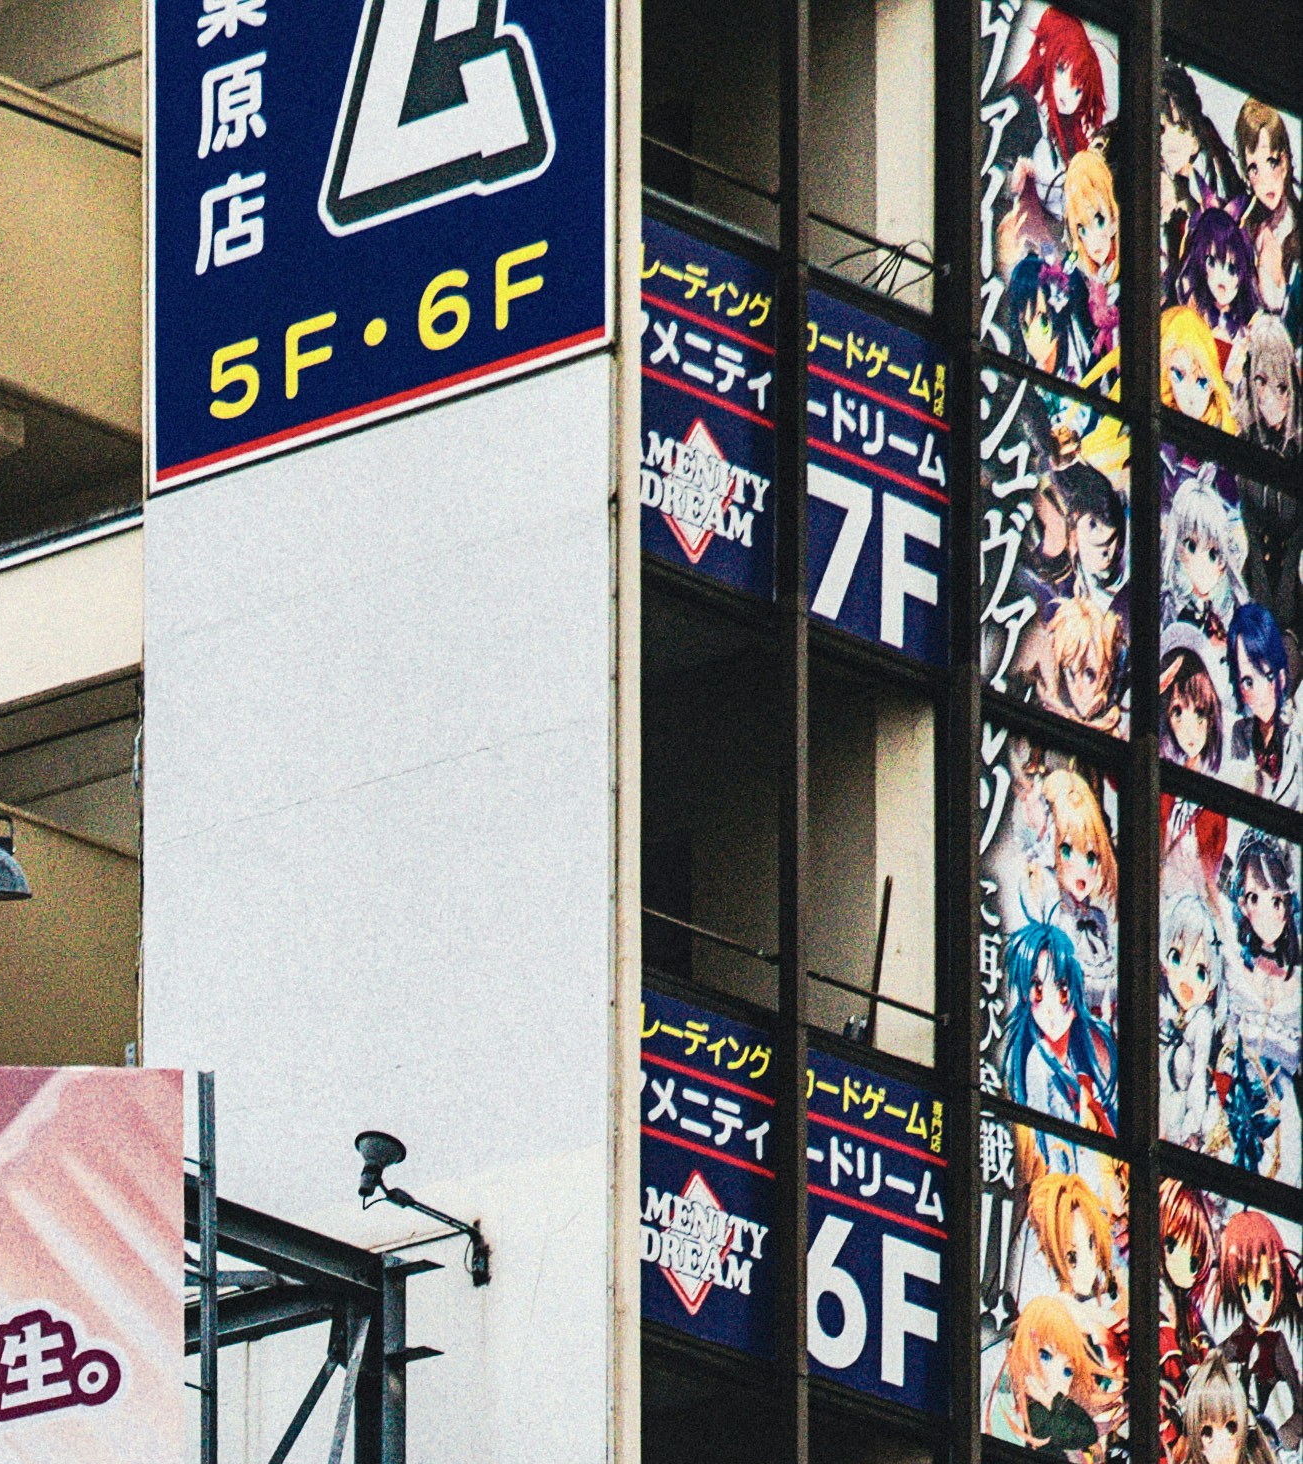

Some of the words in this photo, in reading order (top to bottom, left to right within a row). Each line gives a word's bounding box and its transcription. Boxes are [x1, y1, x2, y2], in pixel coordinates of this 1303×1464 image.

[642, 310, 773, 412] メニティ
[641, 469, 755, 548] DREAM
[807, 464, 942, 649] 7F
[641, 1072, 771, 1161] メニティ
[641, 1224, 752, 1296] DREAM
[807, 1214, 941, 1388] 6F
